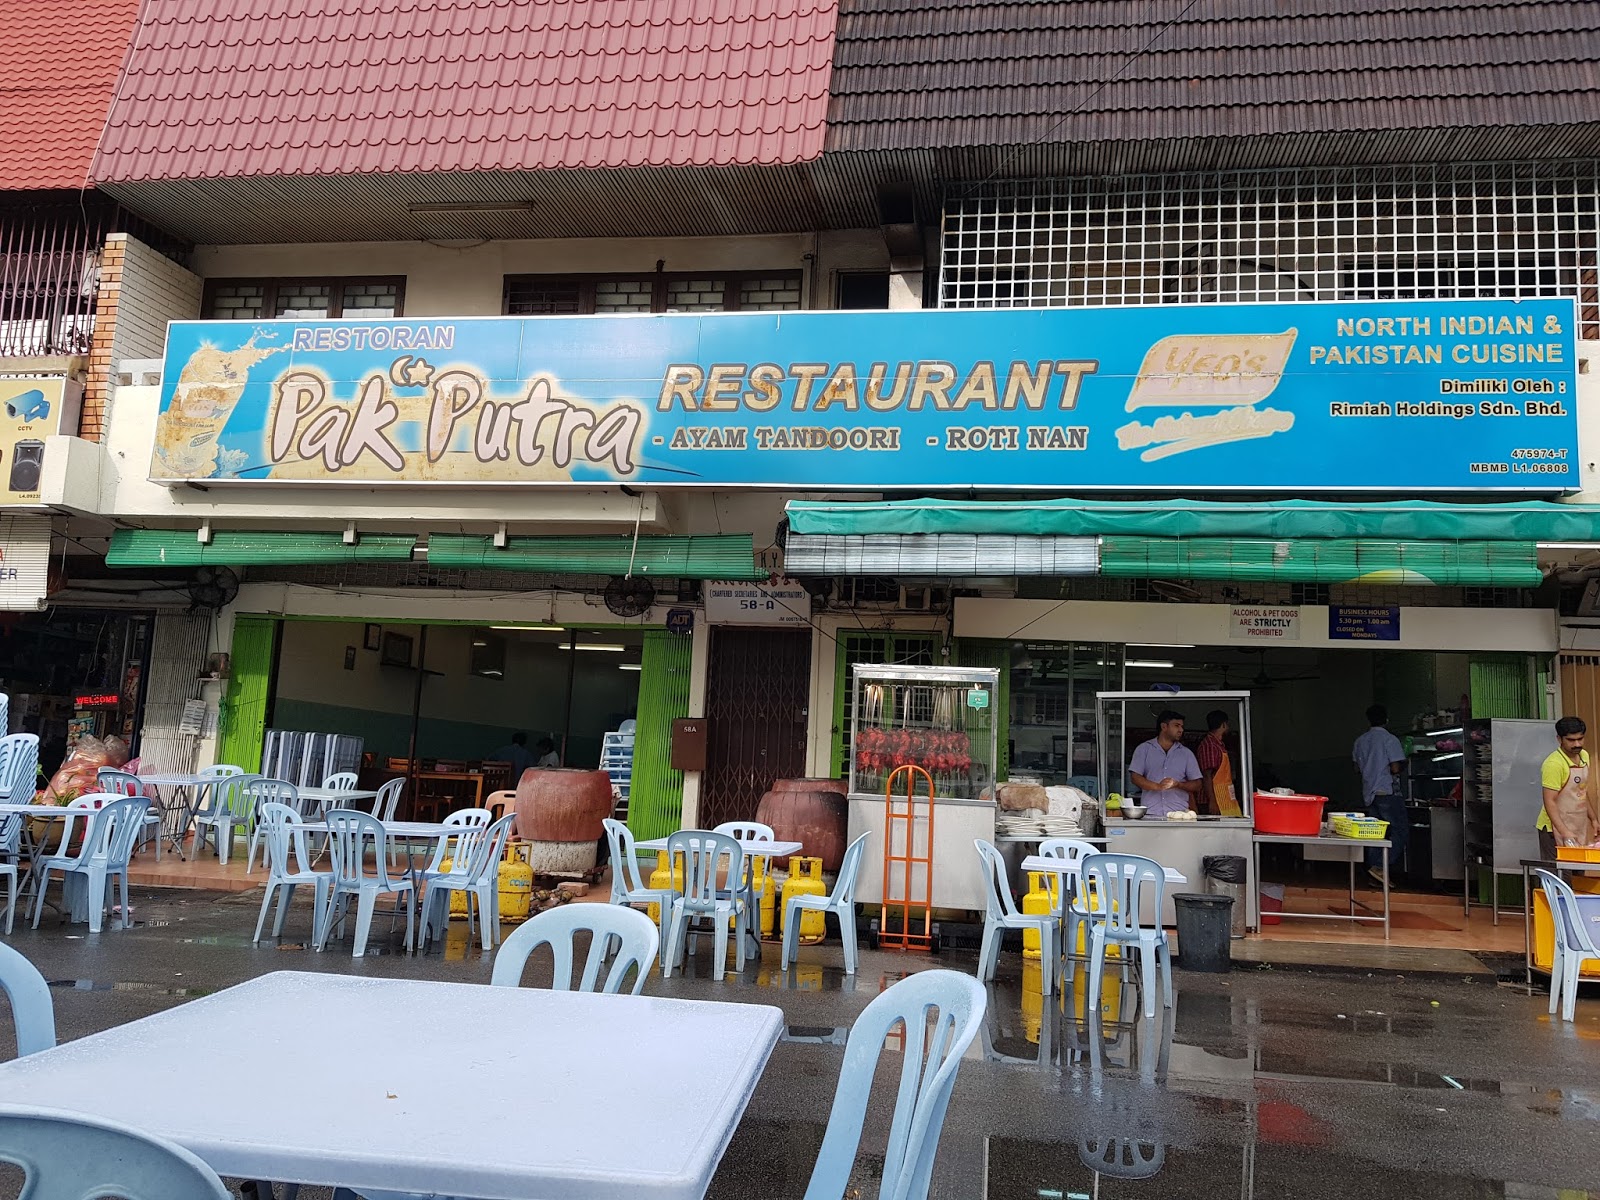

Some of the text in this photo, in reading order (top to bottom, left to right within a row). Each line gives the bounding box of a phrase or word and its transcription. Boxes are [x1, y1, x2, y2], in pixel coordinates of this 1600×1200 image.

[1337, 315, 1562, 336] NORTH INDIAN &
[293, 326, 455, 350] RESTORAN
[1310, 344, 1563, 364] PAKISTAN CUISINE
[656, 360, 1099, 412] RESTAURANT
[1441, 380, 1506, 393] Dimiliki
[1513, 380, 1553, 393] Oleh
[1331, 402, 1566, 417] Rimiah Holdings Sdn. Bhd.
[271, 370, 641, 475] Pak Putra
[670, 428, 747, 449] AYAM
[756, 428, 900, 449] TANDOORI
[947, 427, 1018, 449] ROTI
[1028, 427, 1088, 449] NAN
[1511, 449, 1568, 458] 475974-T
[1470, 463, 1568, 472] MBMB L1.06808
[671, 614, 689, 625] ADT
[1233, 609, 1261, 617] ALCOHOL
[1281, 609, 1298, 617] DOGS
[1240, 618, 1291, 627] ARE STRICTLY
[1248, 628, 1283, 636] PROHIBITED
[76, 695, 118, 705] WELCOME
